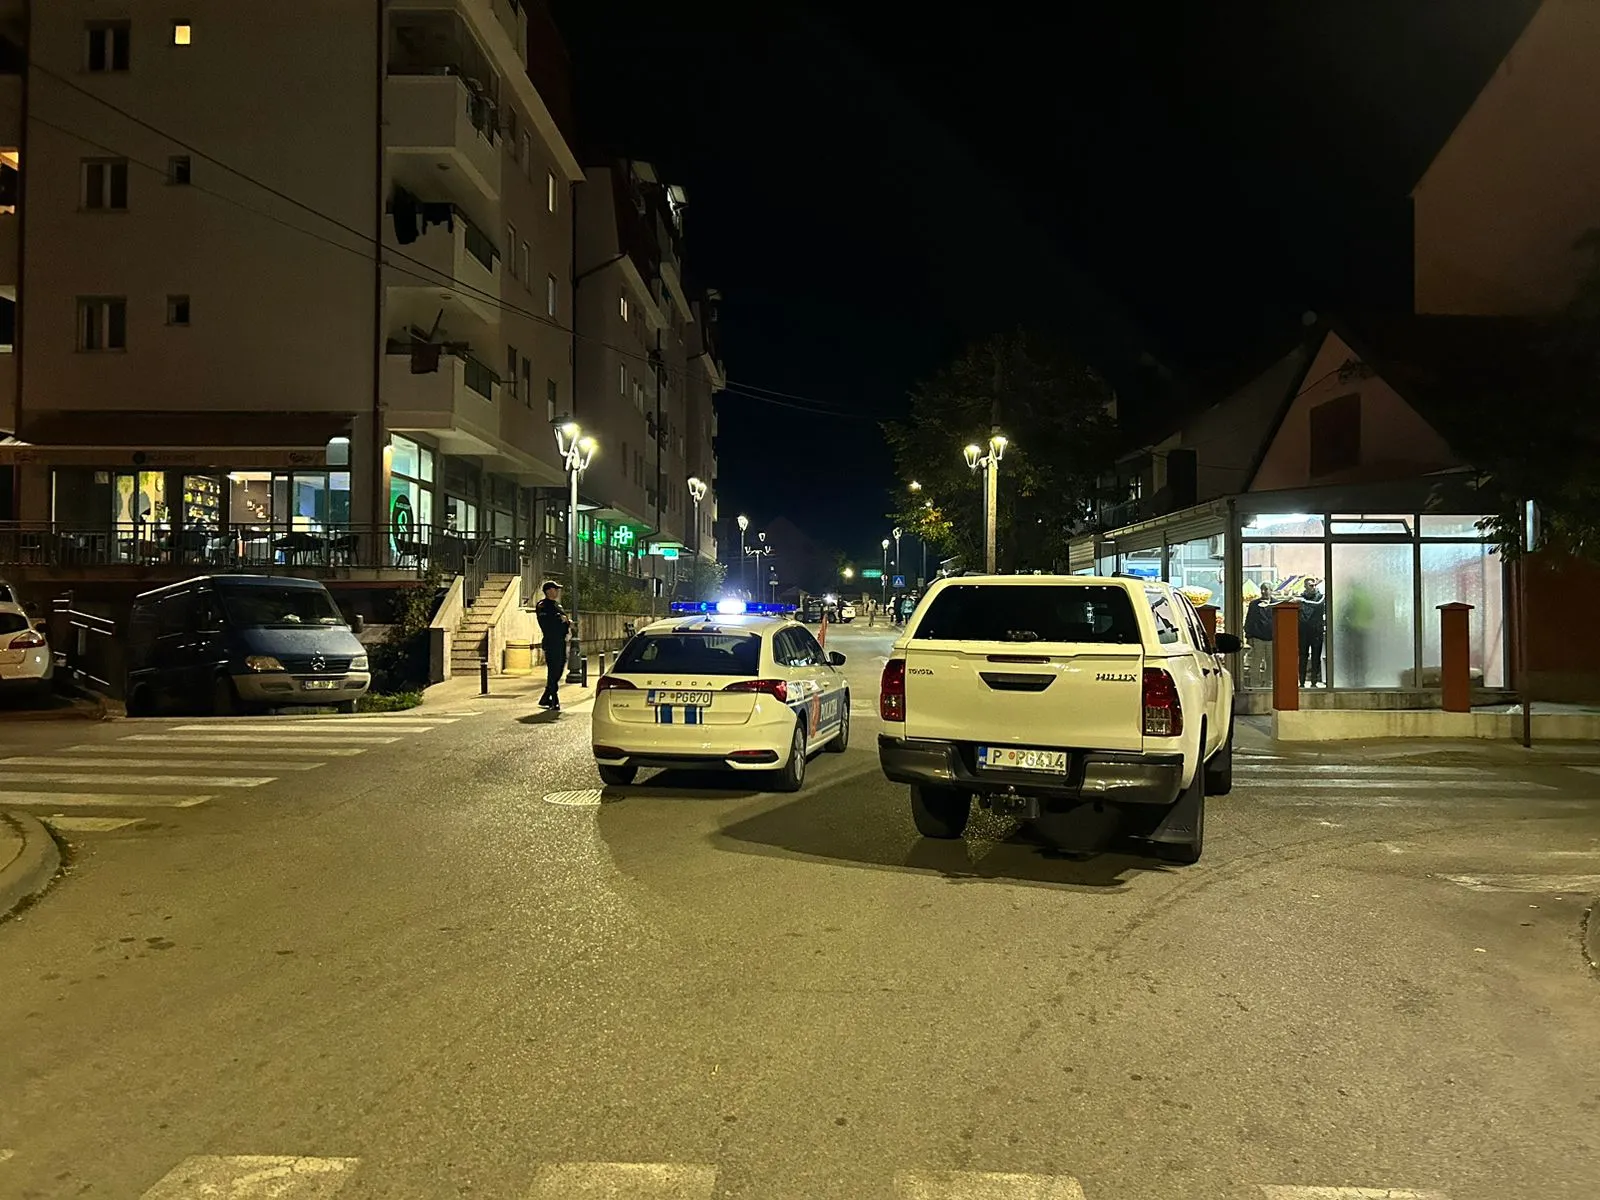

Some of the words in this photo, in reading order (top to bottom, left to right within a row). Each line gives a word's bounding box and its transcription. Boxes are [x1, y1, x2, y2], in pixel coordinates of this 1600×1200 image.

[908, 668, 934, 676] TOYOTA
[1095, 673, 1138, 682] HILUX
[658, 691, 667, 702] P
[675, 692, 710, 704] PG670
[992, 748, 1003, 764] P
[1015, 750, 1066, 769] PG414
